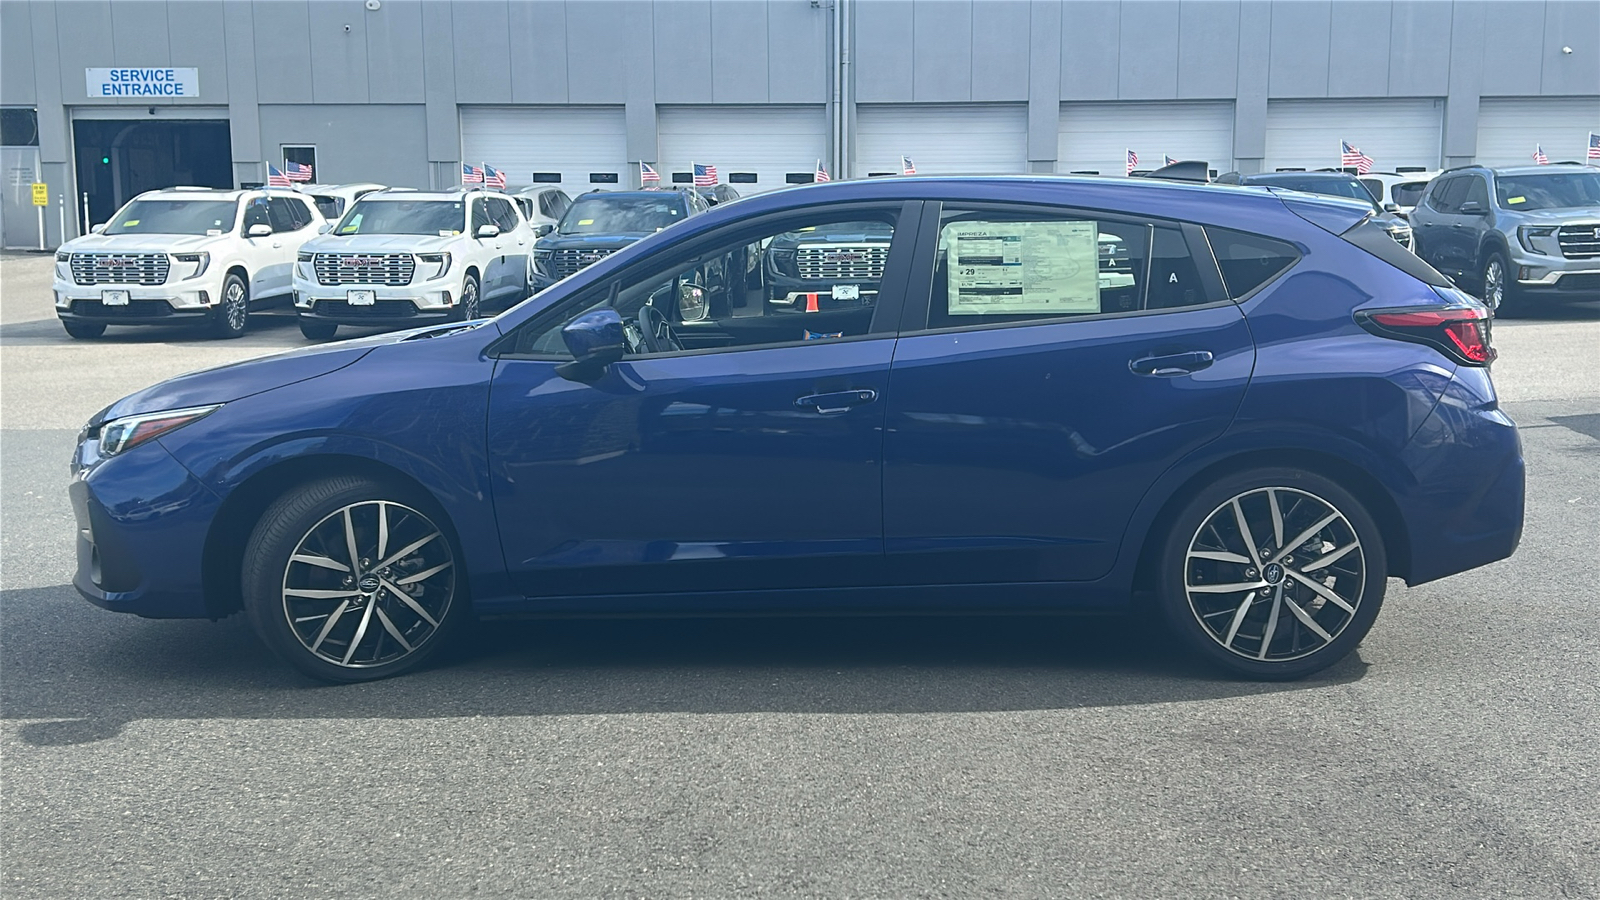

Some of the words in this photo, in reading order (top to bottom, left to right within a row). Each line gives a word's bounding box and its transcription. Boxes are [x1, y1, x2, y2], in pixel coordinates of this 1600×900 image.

[110, 69, 174, 81] SERVICE
[102, 83, 184, 95] ENTRANCE
[99, 258, 136, 267] GMC
[344, 258, 380, 267] GMC
[1169, 272, 1178, 283] A
